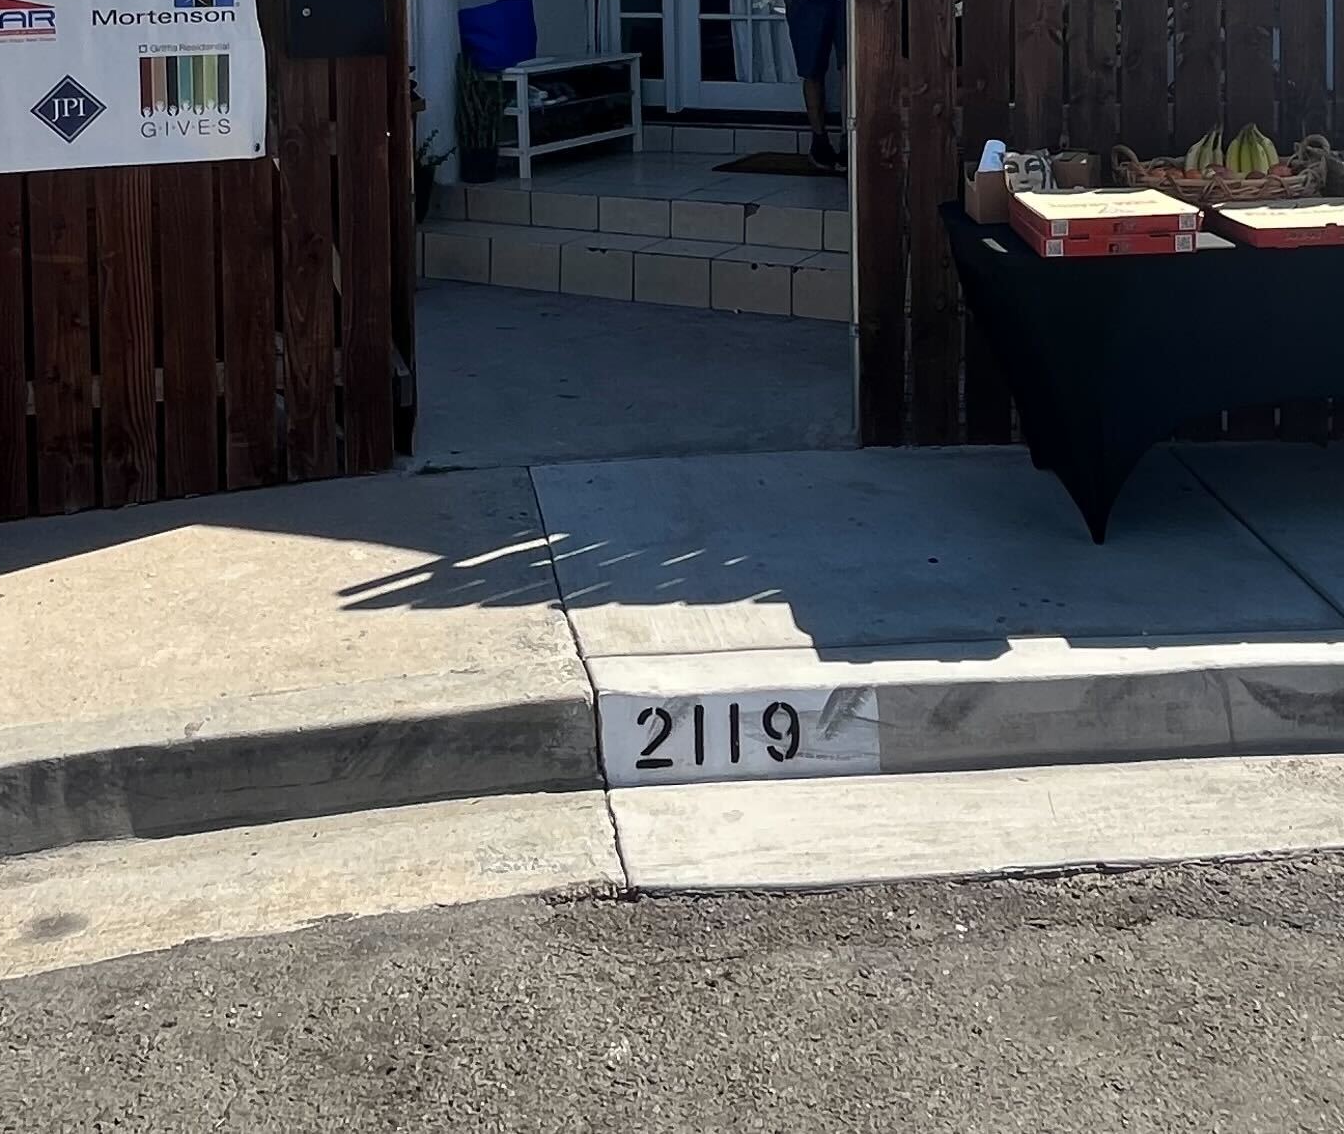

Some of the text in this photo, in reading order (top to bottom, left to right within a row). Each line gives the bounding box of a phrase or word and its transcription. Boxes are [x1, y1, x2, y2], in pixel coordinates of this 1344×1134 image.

[91, 9, 236, 27] Mortenson
[51, 97, 86, 123] JPI
[635, 701, 801, 770] 2119
